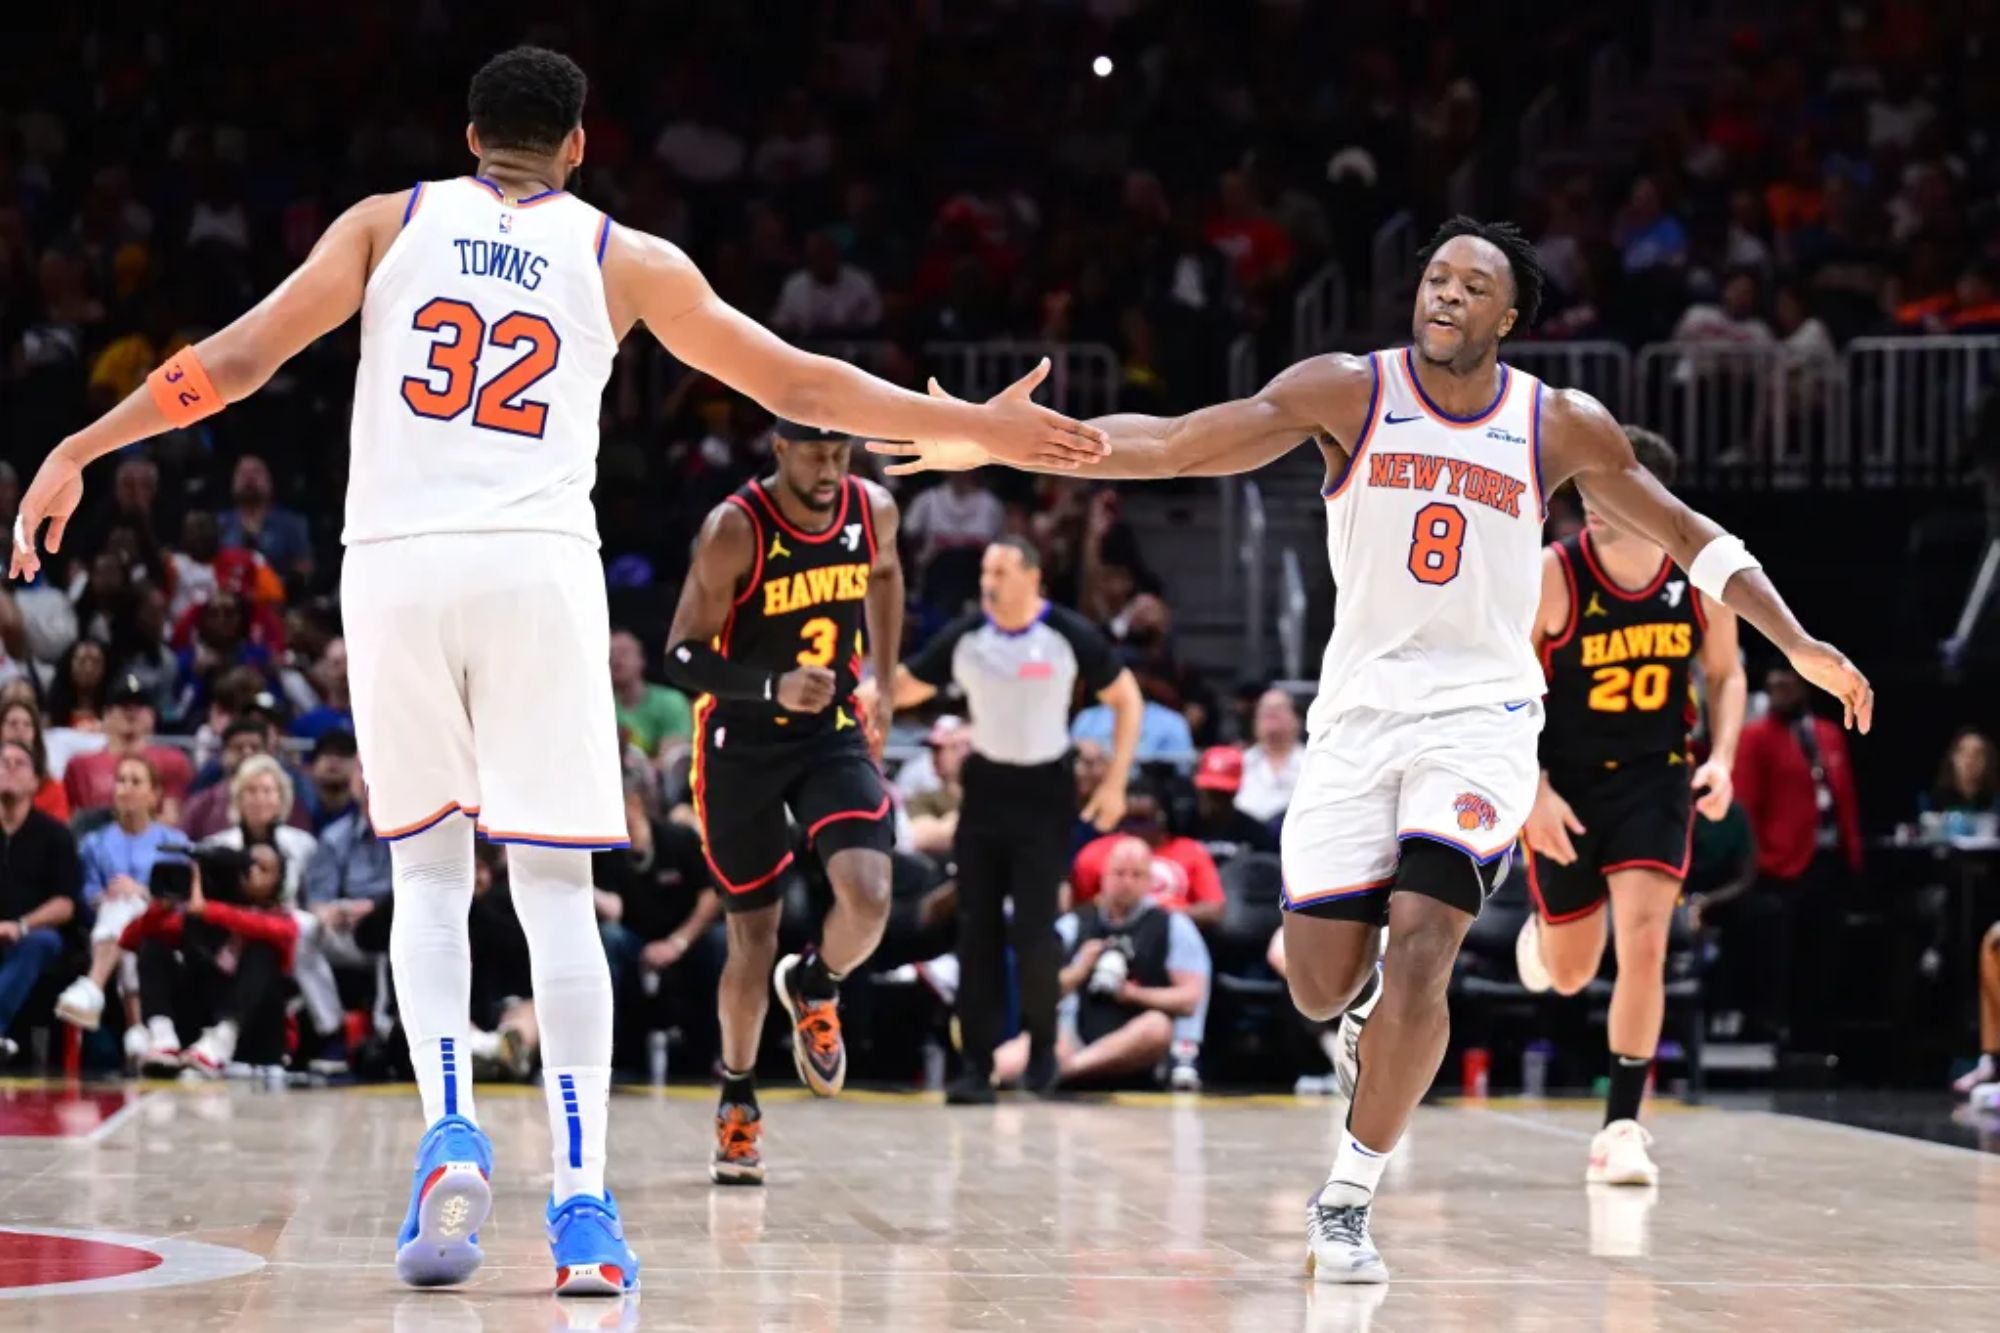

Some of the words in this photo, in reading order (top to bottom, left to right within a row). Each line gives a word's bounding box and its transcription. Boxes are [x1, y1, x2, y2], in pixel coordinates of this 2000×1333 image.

[453, 238, 549, 291] TOWNS
[401, 296, 561, 439] 32
[1368, 453, 1445, 491] NEW
[1447, 458, 1527, 519] YORK
[1407, 502, 1467, 586] 8
[763, 563, 870, 616] HAWKS
[796, 616, 838, 669] 3
[1581, 622, 1692, 668] HAWKS
[1587, 663, 1671, 713] 20
